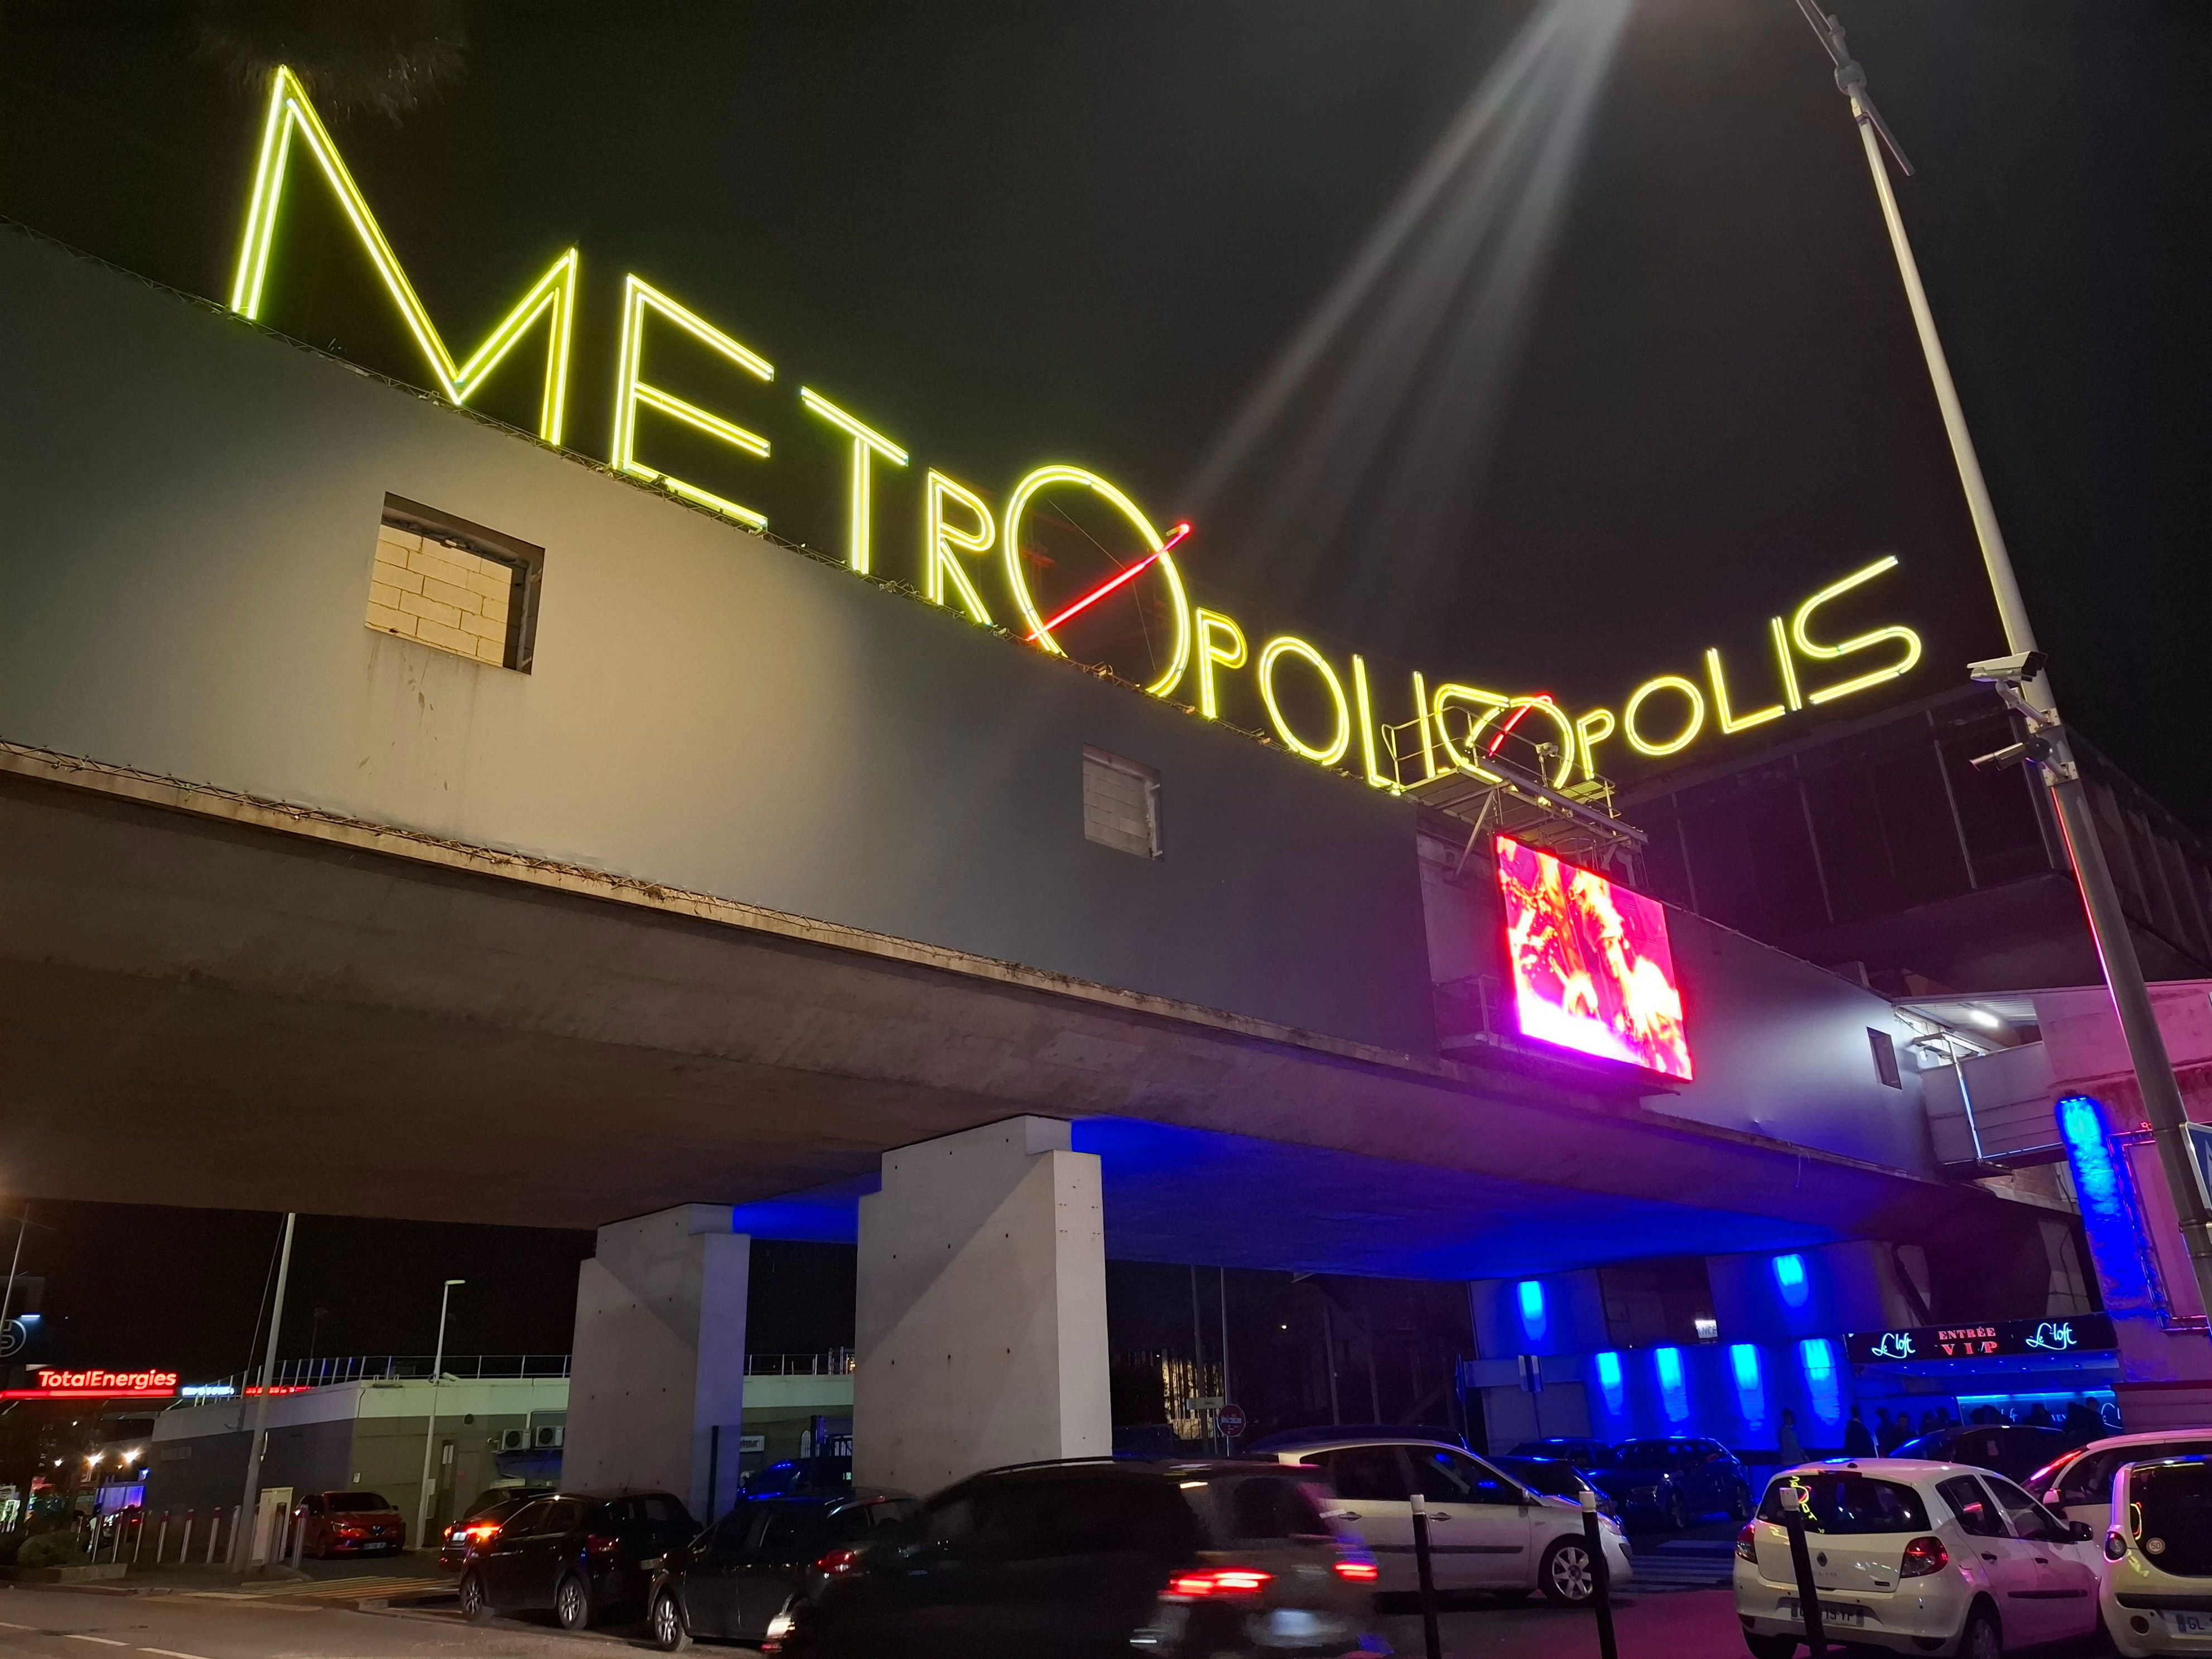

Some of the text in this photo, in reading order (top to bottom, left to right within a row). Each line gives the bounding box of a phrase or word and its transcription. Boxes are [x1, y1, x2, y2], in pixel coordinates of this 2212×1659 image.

[229, 64, 1510, 795] METROPOLIS
[1938, 1326, 1996, 1340] ENTRÉE
[38, 1369, 177, 1390] TotalEnergies
